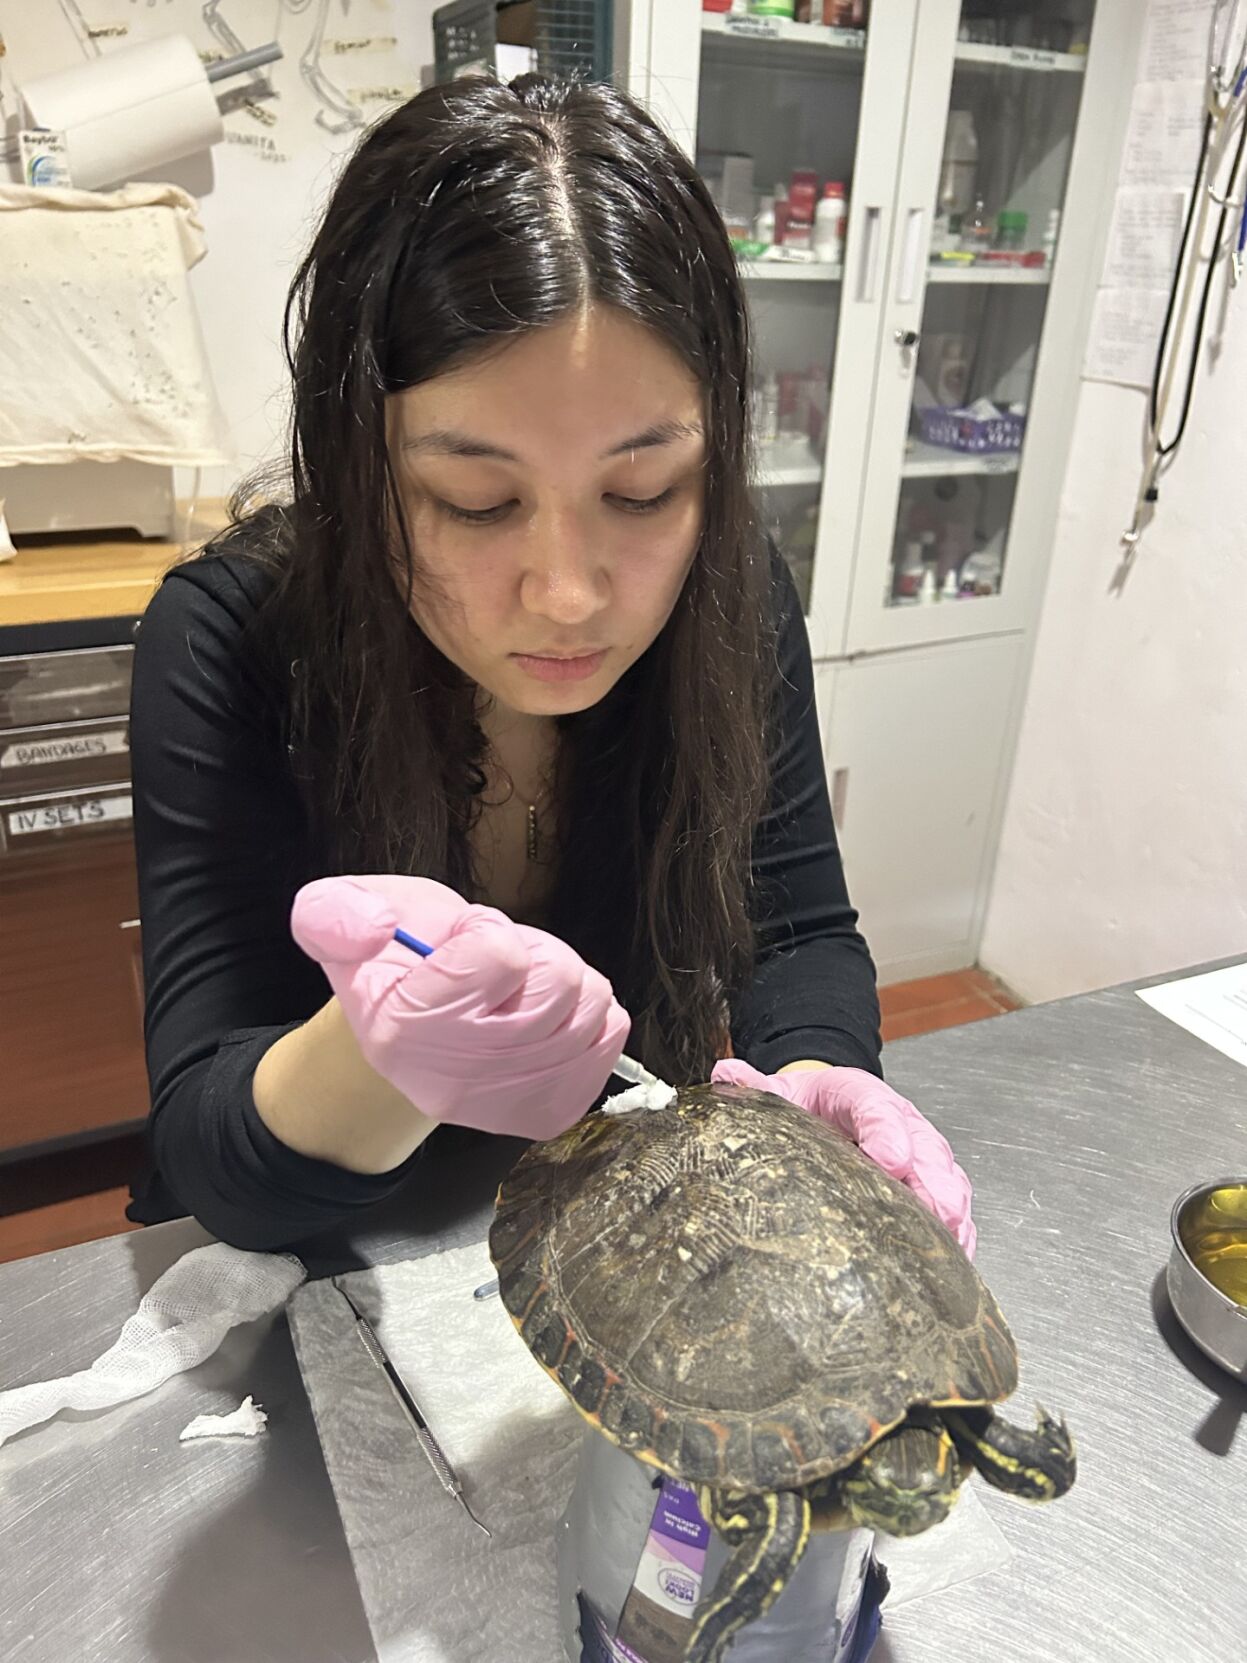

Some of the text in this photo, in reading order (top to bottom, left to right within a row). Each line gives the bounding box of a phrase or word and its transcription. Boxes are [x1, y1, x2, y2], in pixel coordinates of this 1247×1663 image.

[16, 737, 107, 764] BANDAGES
[18, 800, 105, 829] IV SETS
[663, 1510, 702, 1530] Calcium
[664, 1585, 694, 1602] NEW
